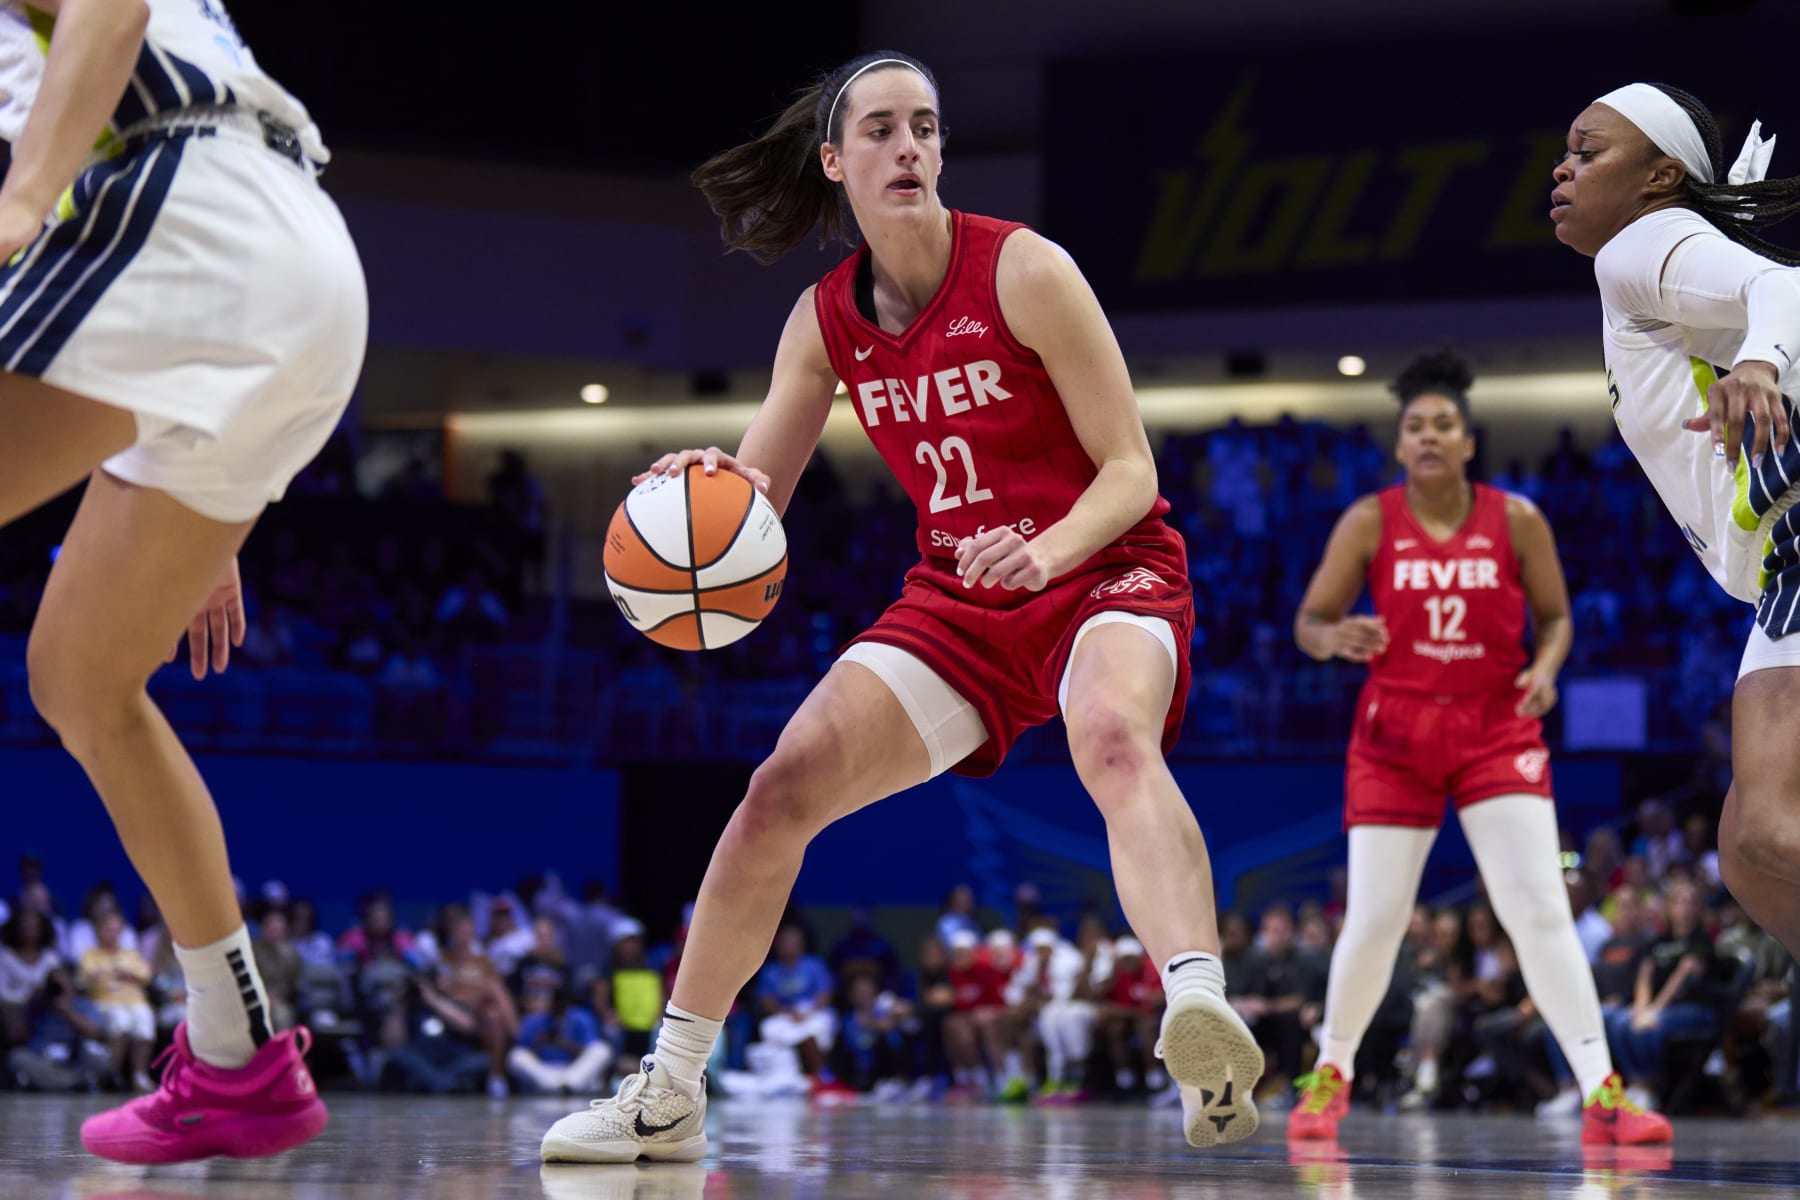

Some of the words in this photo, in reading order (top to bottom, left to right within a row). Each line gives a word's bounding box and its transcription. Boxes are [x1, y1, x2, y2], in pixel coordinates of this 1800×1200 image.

[1133, 68, 1490, 283] VOLT
[946, 316, 989, 338] Lilly
[858, 359, 1013, 427] FEVER
[915, 436, 993, 514] 22
[1393, 557, 1499, 590] FEVER
[1423, 595, 1467, 640] 12
